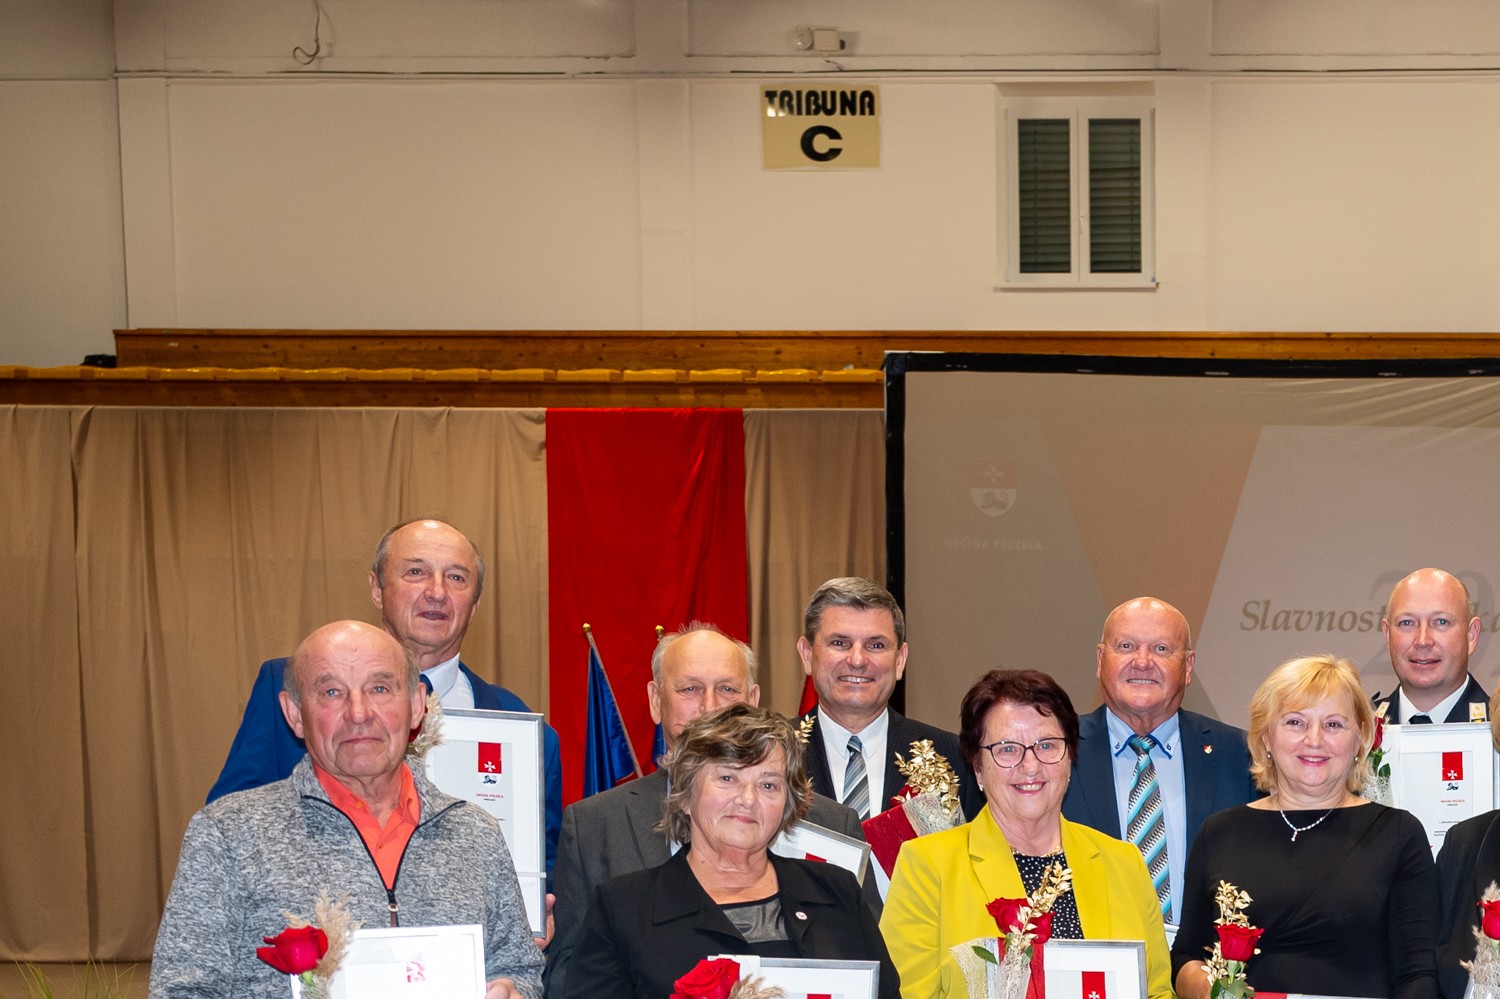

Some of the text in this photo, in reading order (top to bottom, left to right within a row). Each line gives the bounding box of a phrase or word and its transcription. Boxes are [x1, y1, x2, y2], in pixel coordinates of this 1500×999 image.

[764, 89, 876, 117] TRIBUNA
[800, 125, 843, 162] C
[1240, 599, 1389, 632] Slavnost
